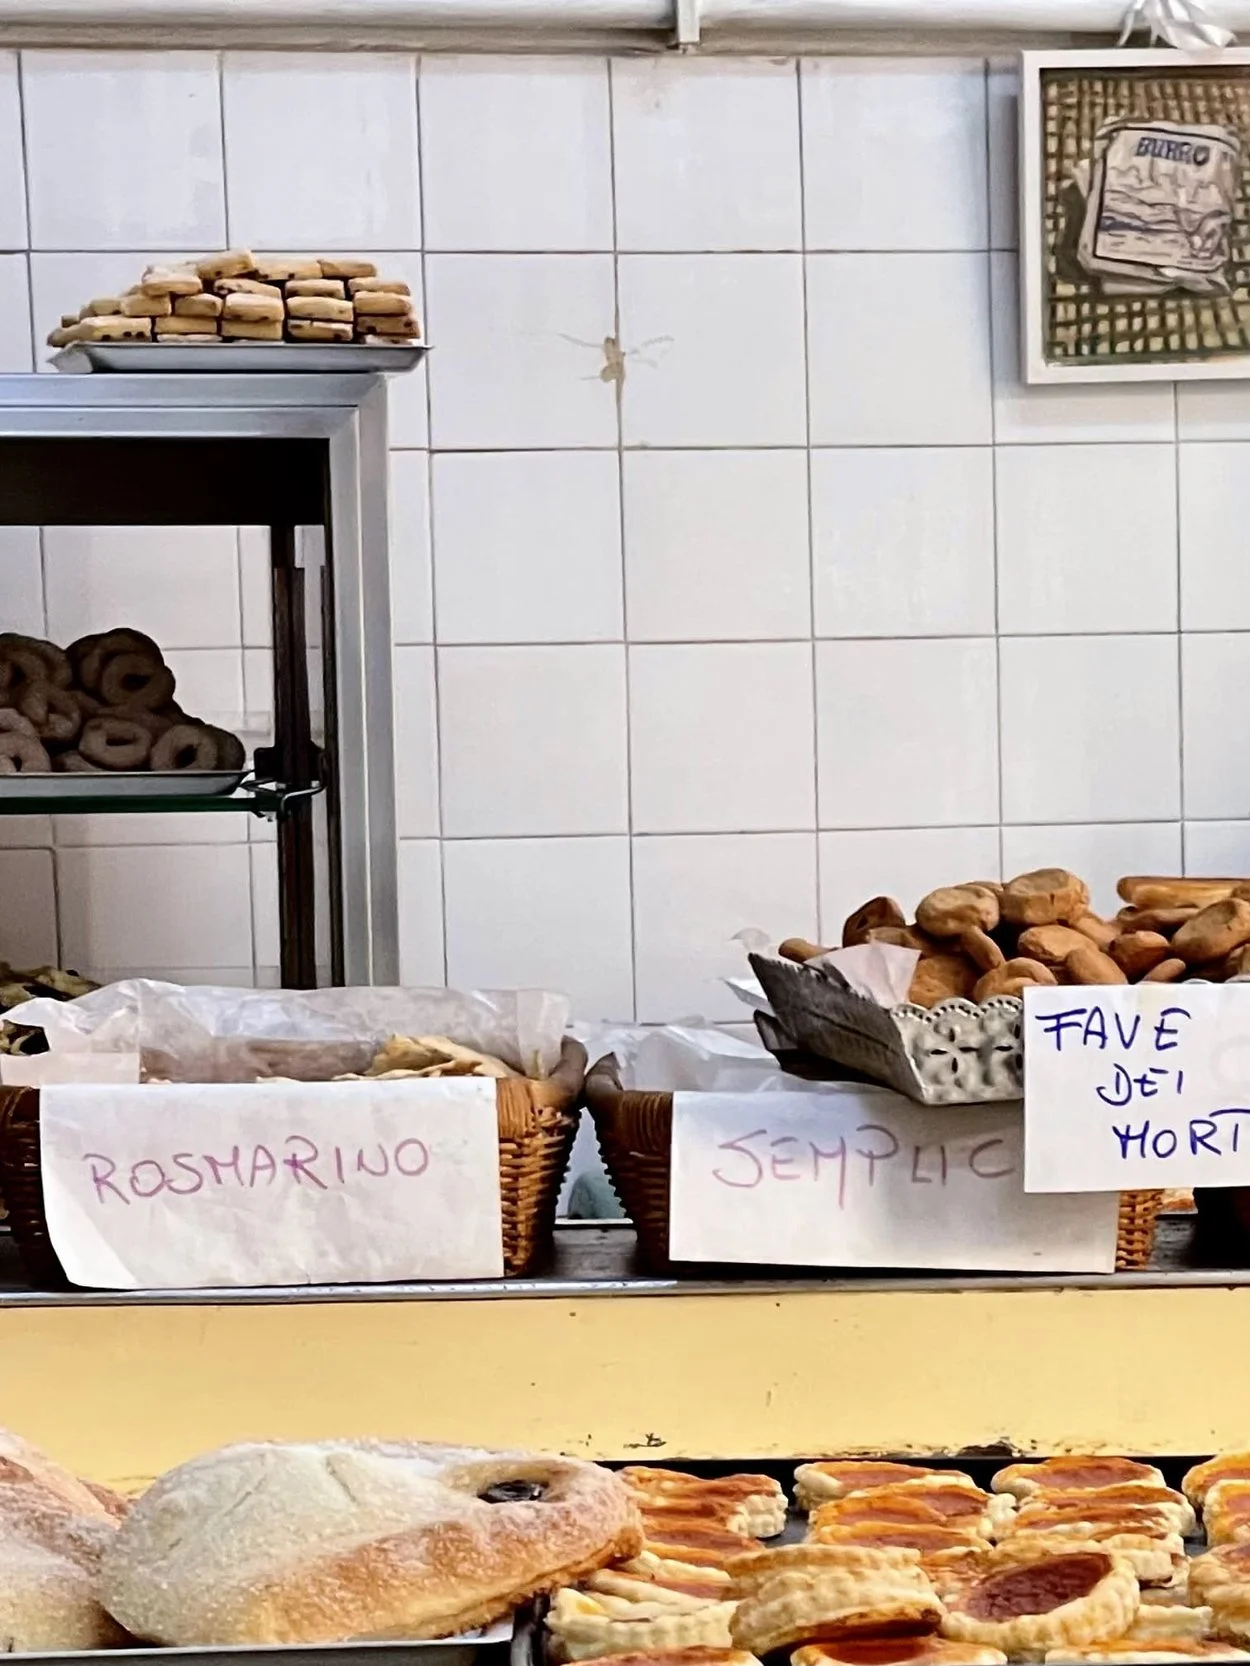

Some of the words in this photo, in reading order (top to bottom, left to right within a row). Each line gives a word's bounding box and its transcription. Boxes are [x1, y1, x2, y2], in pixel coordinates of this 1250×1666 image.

[1034, 1006, 1191, 1053] FAVE
[1096, 1063, 1184, 1106] DEI
[82, 1135, 430, 1206] ROSMARINO
[712, 1124, 1016, 1209] SEMPLIC
